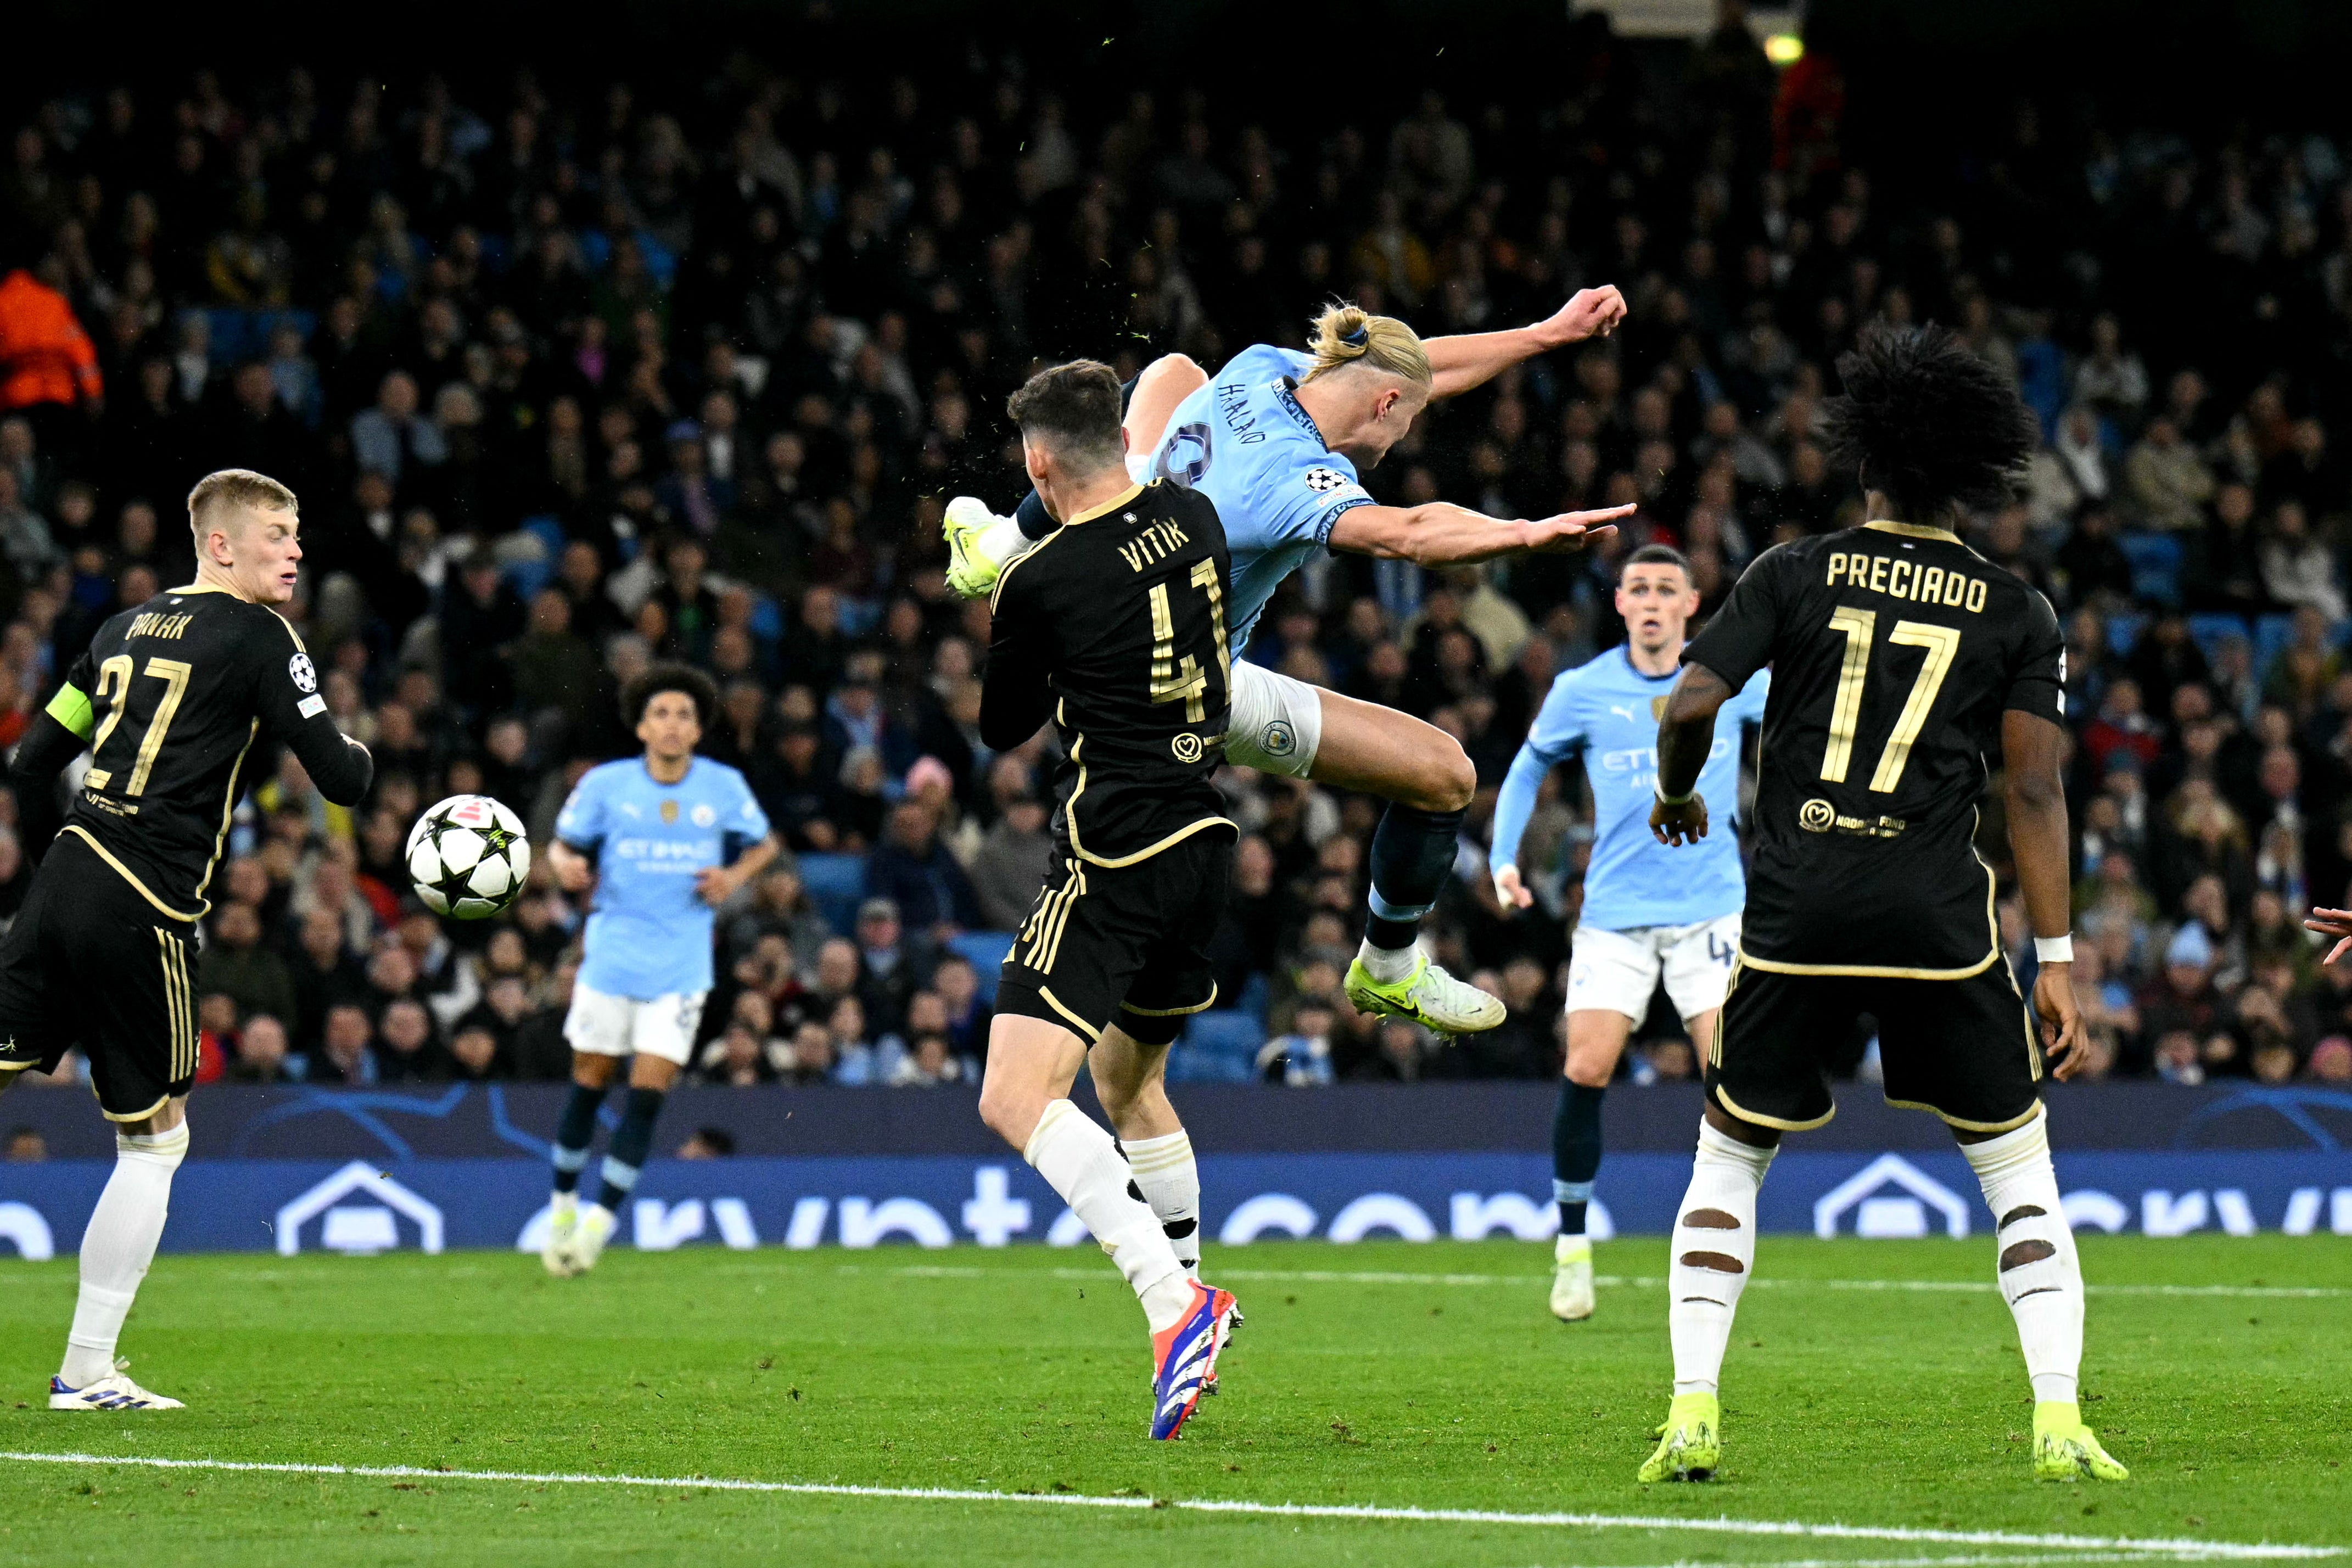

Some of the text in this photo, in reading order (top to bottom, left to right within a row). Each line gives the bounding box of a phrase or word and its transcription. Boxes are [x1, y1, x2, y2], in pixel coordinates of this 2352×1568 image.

[1117, 517, 1190, 573] VITÍK
[1827, 552, 1987, 613] PRECIADO
[1149, 556, 1231, 723] 41
[83, 654, 192, 797] 27
[1820, 606, 1961, 794] 17
[1602, 738, 1731, 771] ETID
[1708, 932, 1735, 967] 4
